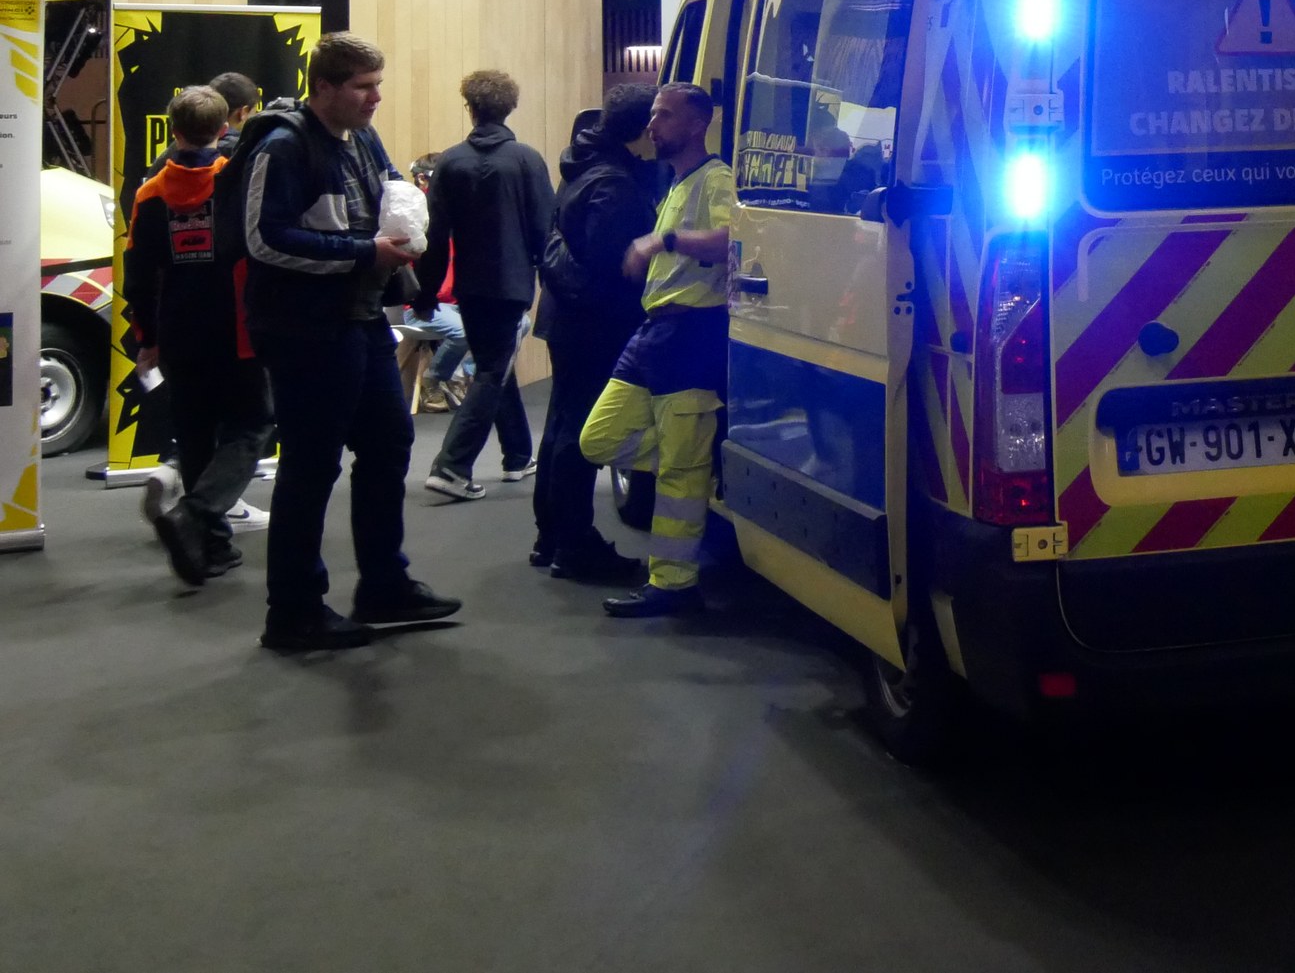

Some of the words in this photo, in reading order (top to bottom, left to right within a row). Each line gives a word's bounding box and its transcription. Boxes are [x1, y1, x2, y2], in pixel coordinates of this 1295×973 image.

[1129, 108, 1265, 136] CHANGEZ
[1102, 165, 1186, 189] Protégez
[1192, 169, 1236, 184] ceux
[1242, 165, 1270, 185] qui
